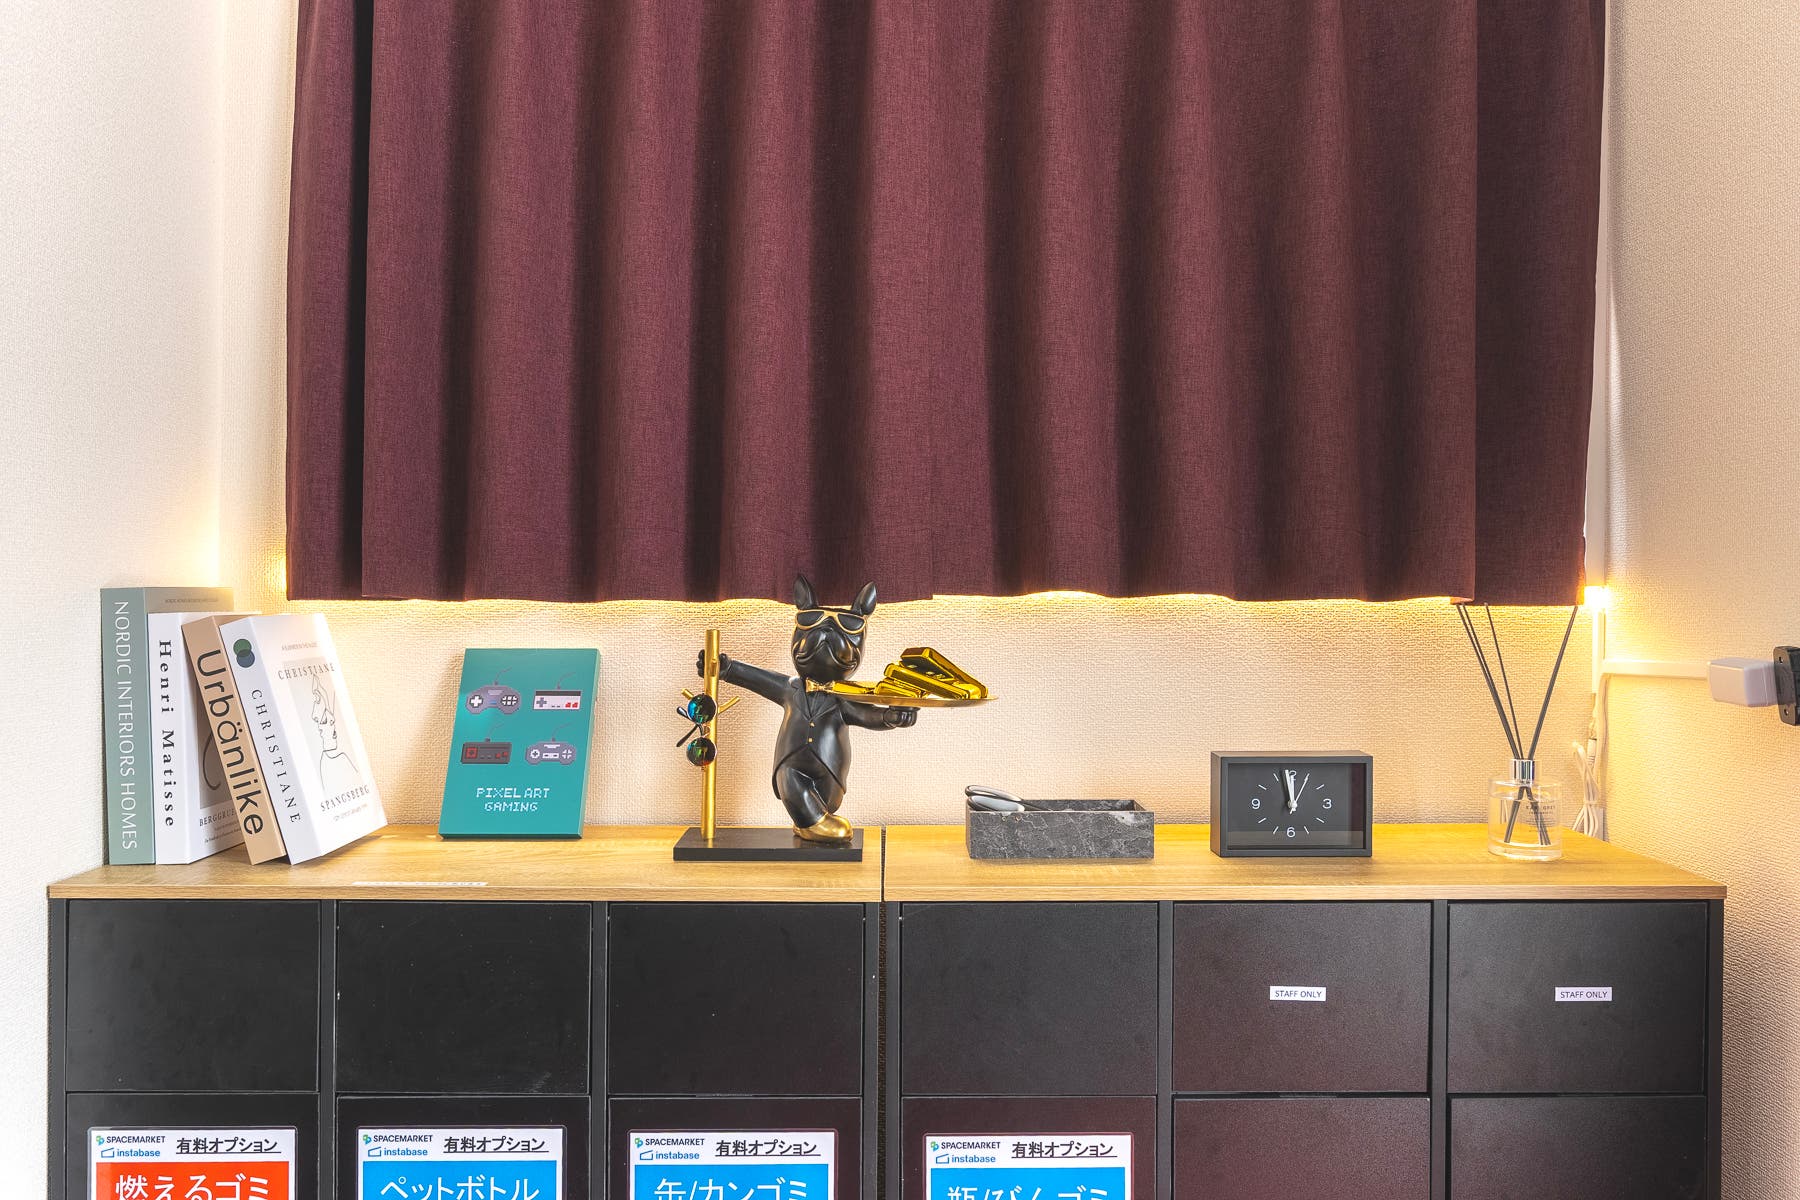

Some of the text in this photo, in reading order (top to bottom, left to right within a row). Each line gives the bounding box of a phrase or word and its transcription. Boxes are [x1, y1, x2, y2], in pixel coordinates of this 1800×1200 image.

[278, 662, 335, 680] CHRISTIANE
[114, 601, 137, 849] NORDIC INTERIORS HOMES
[159, 640, 176, 827] Henri Matisse
[197, 650, 264, 835] Urbänlike
[251, 689, 301, 823] CHRISTIANE
[476, 787, 550, 798] PIXEL ART
[484, 802, 538, 812] GAMING
[1251, 798, 1261, 810] 9
[1322, 798, 1332, 809] 3
[1286, 827, 1296, 838] 6
[1275, 990, 1322, 998] STAFF ONLY
[1560, 991, 1608, 999] STAFF ONLY
[106, 1136, 165, 1144] SPACEMARKET
[373, 1135, 433, 1143] SPACEMARKET
[444, 1136, 546, 1152] 有料オプション
[645, 1138, 705, 1146] SPACEMARKET
[176, 1137, 278, 1153] 有料オプション
[716, 1139, 817, 1155] 有料オプション
[941, 1141, 1000, 1149] SPACEMARKET
[1011, 1141, 1114, 1157] 有料オプション
[116, 1148, 161, 1157] instabase
[384, 1147, 428, 1156] instabase
[655, 1151, 700, 1160] instabase
[951, 1154, 996, 1163] instabase
